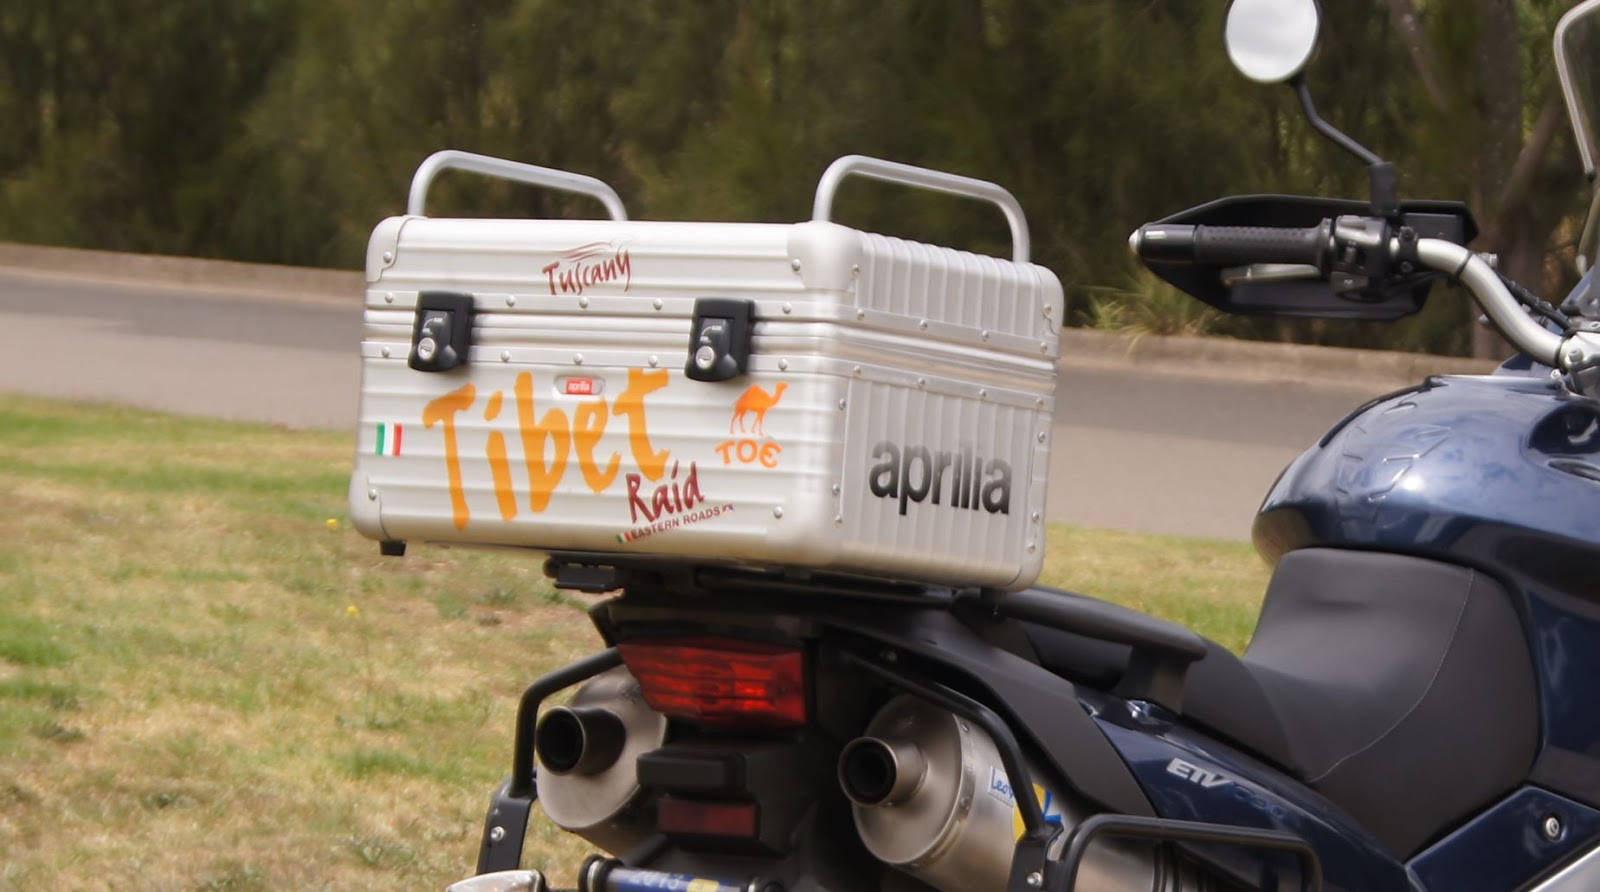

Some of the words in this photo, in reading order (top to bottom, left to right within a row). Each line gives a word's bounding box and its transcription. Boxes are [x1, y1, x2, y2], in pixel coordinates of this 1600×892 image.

[542, 249, 630, 295] Tuscany
[423, 368, 670, 530] Tibet
[715, 439, 783, 468] TOE
[626, 460, 704, 524] Raid
[869, 439, 1012, 516] aprilia
[631, 517, 680, 540] EASTERN
[682, 506, 721, 525] ROADS
[1166, 757, 1233, 788] ETV
